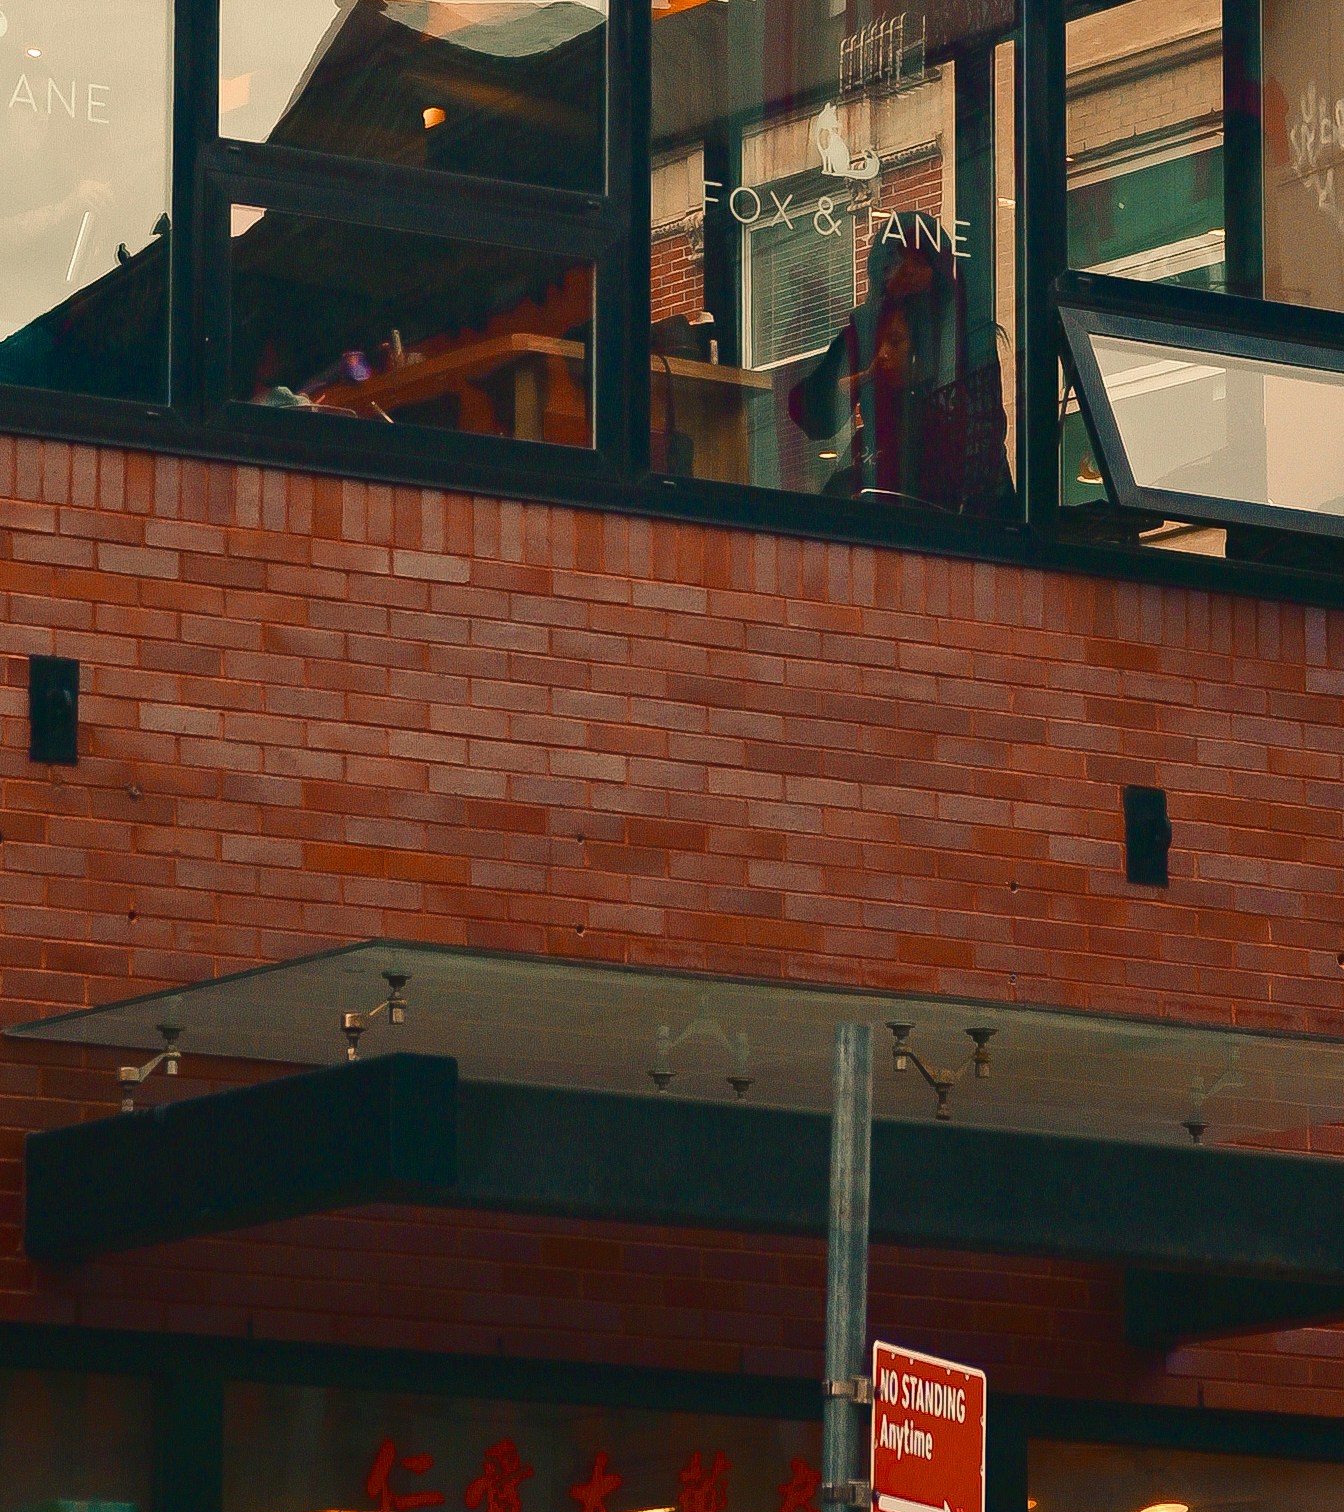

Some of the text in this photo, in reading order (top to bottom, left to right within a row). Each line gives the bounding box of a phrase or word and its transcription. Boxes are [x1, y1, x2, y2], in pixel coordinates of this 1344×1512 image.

[704, 179, 972, 258] FOX & JANE
[880, 1367, 966, 1425] NO STANDING
[879, 1413, 934, 1461] Anytime
